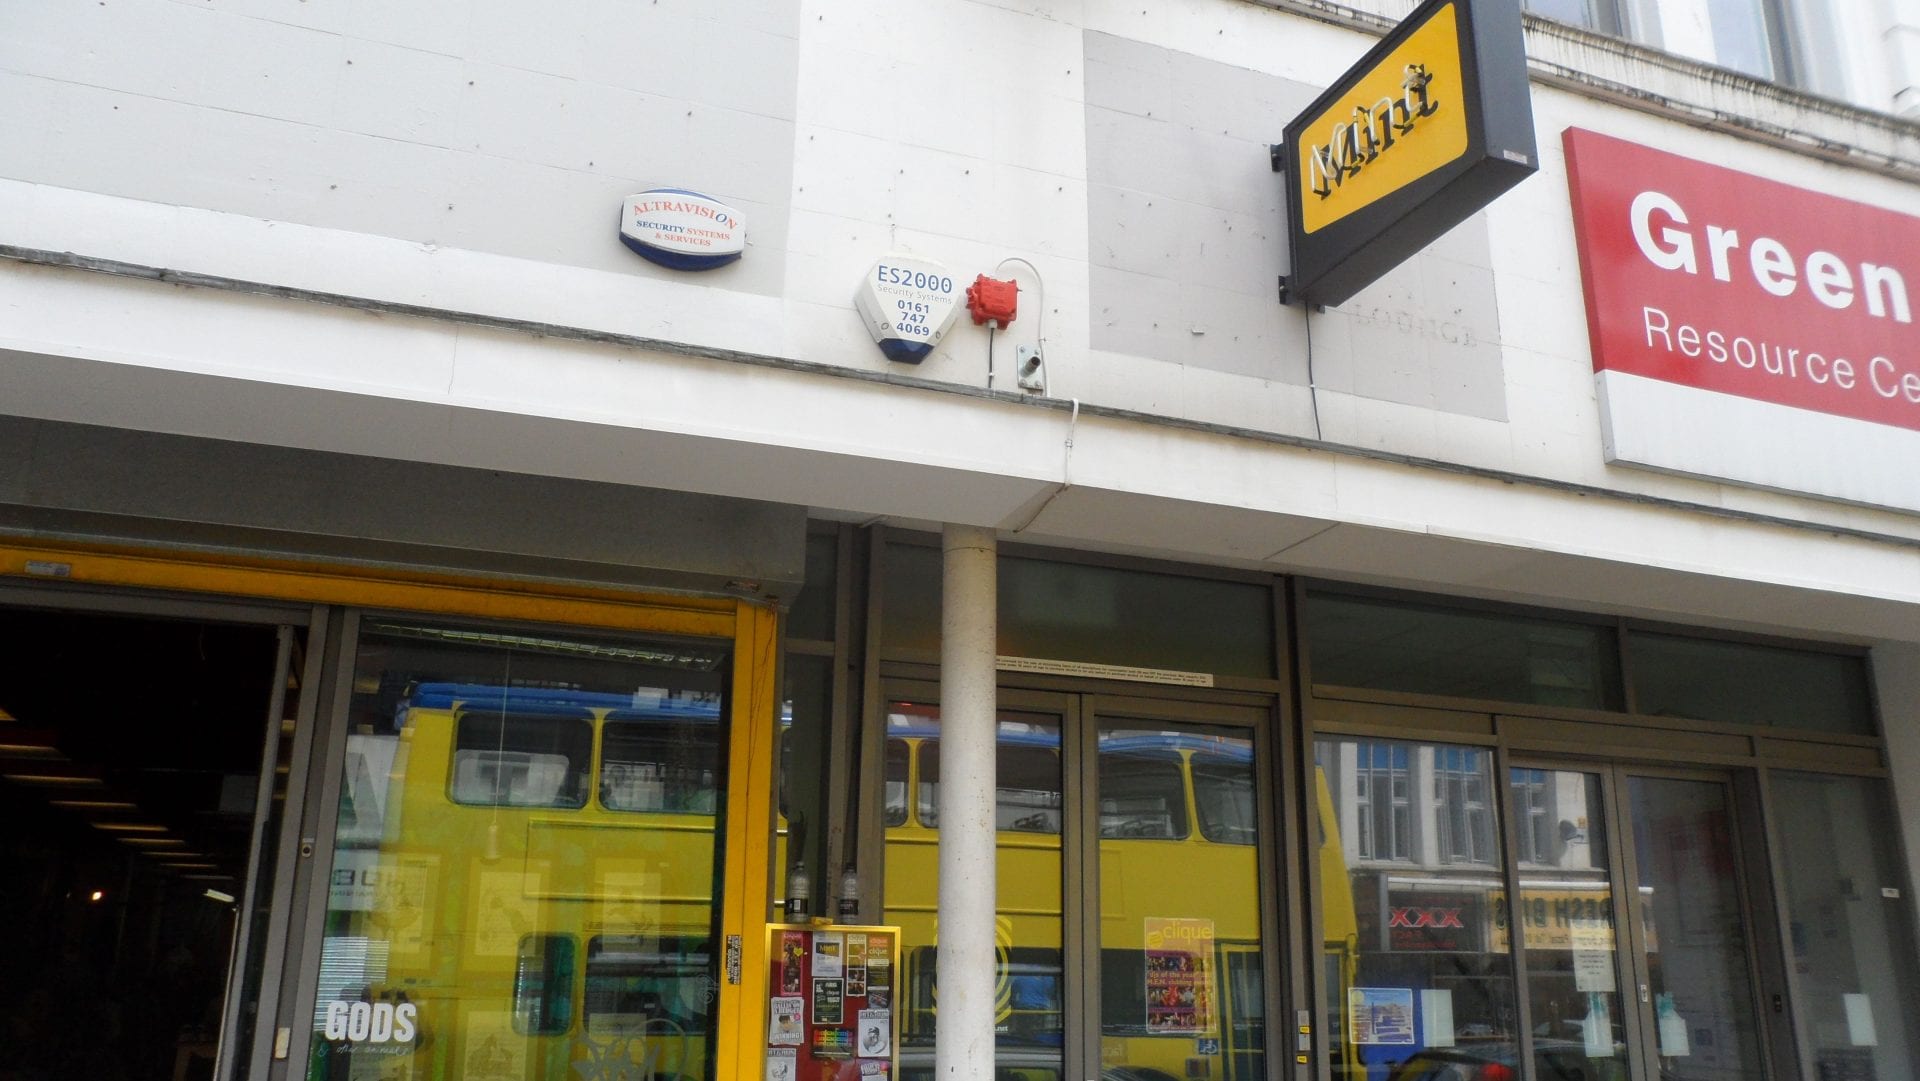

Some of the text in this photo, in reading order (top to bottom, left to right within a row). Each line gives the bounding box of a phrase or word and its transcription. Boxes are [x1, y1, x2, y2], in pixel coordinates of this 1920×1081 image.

[1311, 64, 1439, 200] Mint
[633, 201, 737, 229] ALTRAVISION
[636, 220, 730, 240] SECURITY SYSTEMS
[656, 232, 711, 246] & SERVICES
[1630, 191, 1912, 323] Green
[878, 265, 953, 293] ES2000
[878, 285, 952, 305] Security Systems
[897, 299, 929, 314] 0161
[896, 322, 930, 336] 4069
[902, 311, 925, 324] 747
[1643, 306, 1920, 403] Resource Ce
[1163, 922, 1212, 945] clique
[325, 1001, 416, 1042] GODS
